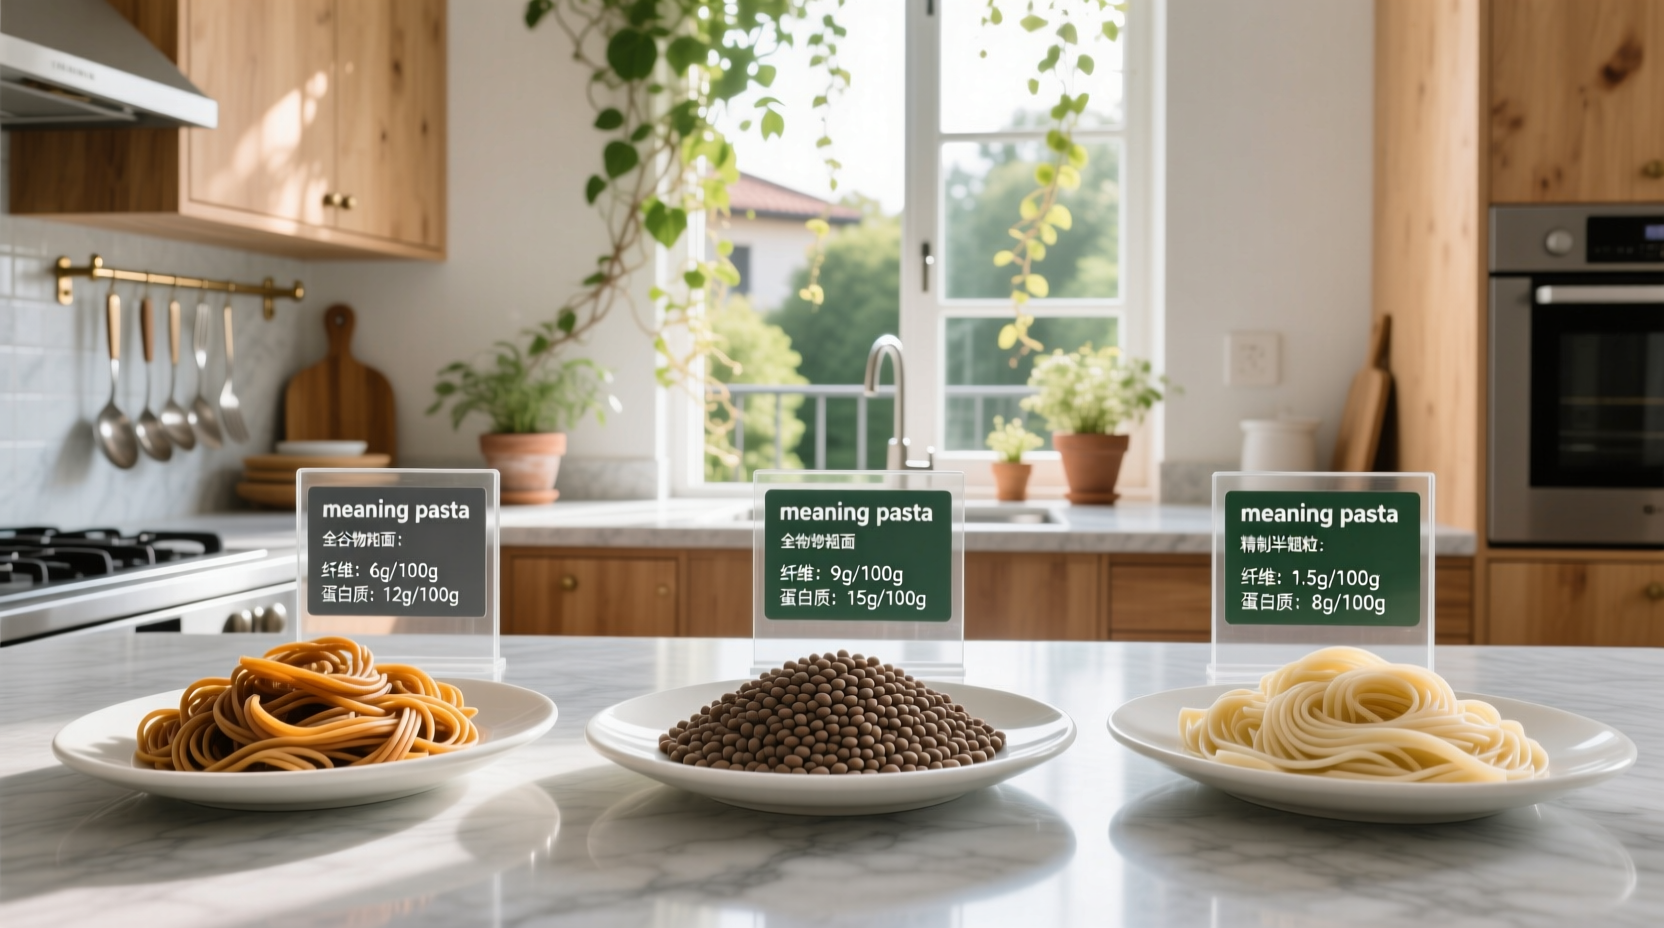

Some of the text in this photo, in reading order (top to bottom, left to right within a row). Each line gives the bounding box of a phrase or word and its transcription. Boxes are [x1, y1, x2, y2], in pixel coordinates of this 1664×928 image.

[322, 498, 470, 523] meaning pasta
[780, 501, 933, 526] meaning pasta
[1241, 502, 1399, 527] meaning pasta
[369, 561, 438, 582] 6g/100g
[830, 565, 903, 586] 9g/100g
[1292, 569, 1380, 590] 1.5g/100g
[383, 586, 459, 606] 12g/100g
[847, 589, 926, 610] 15g/100g
[1311, 593, 1386, 615] 8g/100g
